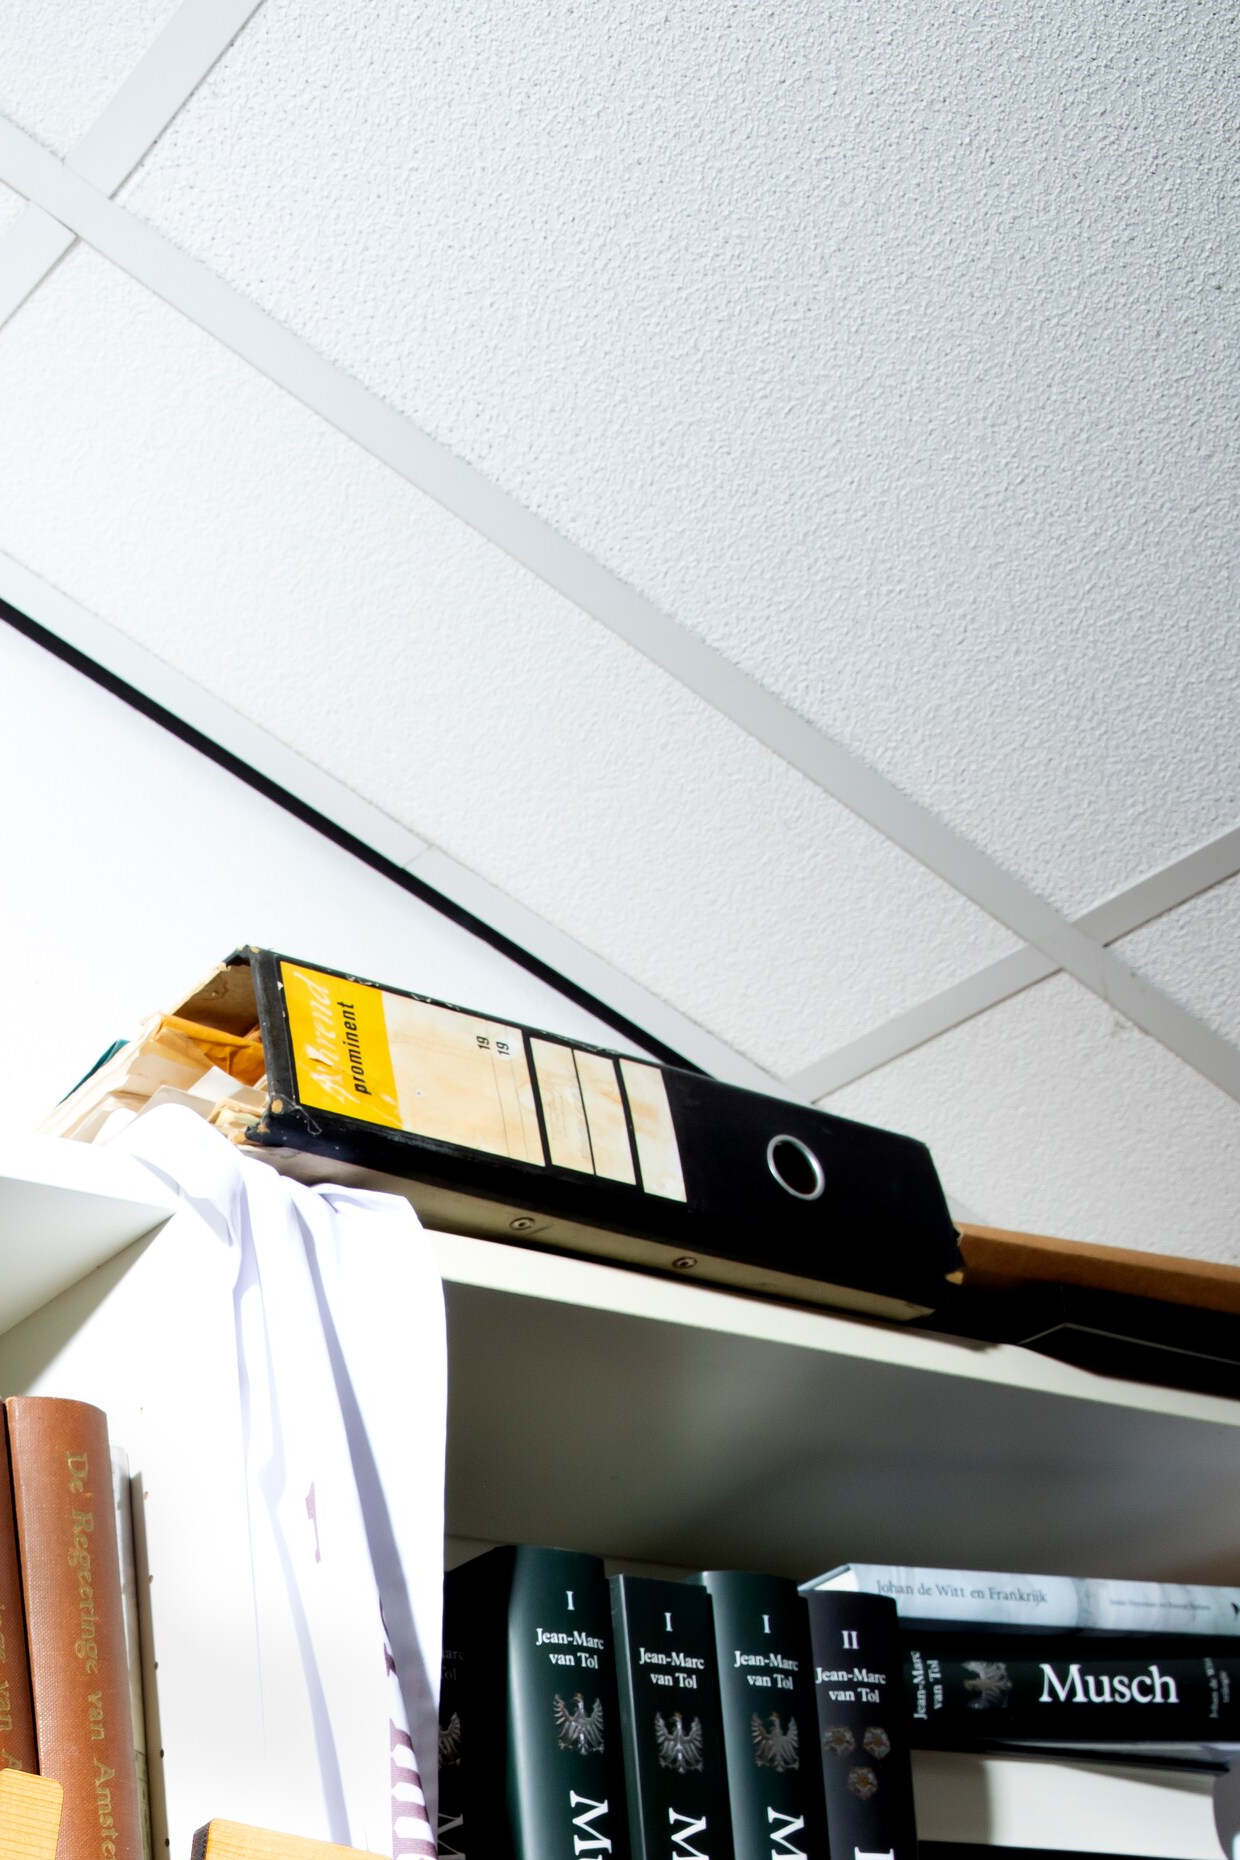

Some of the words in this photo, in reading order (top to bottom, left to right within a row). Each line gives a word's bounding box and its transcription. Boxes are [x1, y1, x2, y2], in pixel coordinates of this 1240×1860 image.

[337, 1000, 372, 1096] prominent
[476, 1035, 491, 1051] 19
[496, 1041, 511, 1057] 19
[64, 1452, 90, 1494] De
[68, 1509, 103, 1675] Regeeringe
[876, 1579, 914, 1597] Johan
[917, 1582, 934, 1597] de
[934, 1583, 965, 1599] Witt
[970, 1588, 986, 1600] en
[988, 1586, 1049, 1608] Frankrijk
[536, 1628, 605, 1650] Jean-Marc
[549, 1653, 575, 1666] van
[577, 1652, 599, 1669] Tol
[639, 1647, 705, 1670] Jean-Marc
[733, 1650, 799, 1671] Jean-Marc
[650, 1673, 674, 1687] van
[675, 1672, 698, 1689] Tol
[747, 1674, 772, 1688] van
[773, 1673, 794, 1690] Tol
[815, 1666, 887, 1685] Jean-Marc
[926, 1659, 943, 1682] Tol
[828, 1690, 856, 1702] van
[857, 1687, 881, 1703] Tol
[910, 1650, 929, 1721] Jean-Marc
[1038, 1663, 1180, 1704] Musch
[933, 1684, 944, 1710] van
[86, 1692, 107, 1742] van
